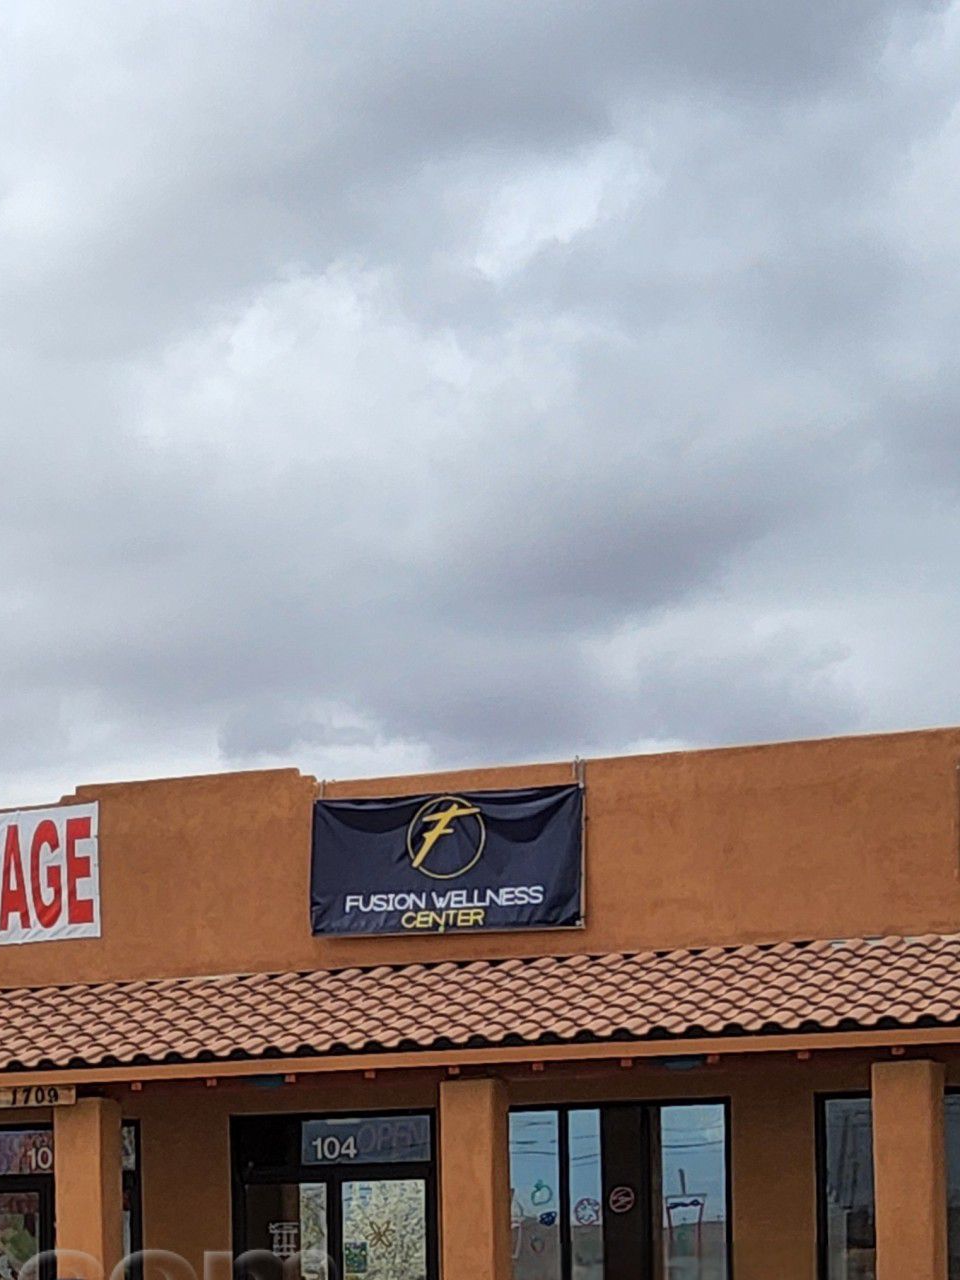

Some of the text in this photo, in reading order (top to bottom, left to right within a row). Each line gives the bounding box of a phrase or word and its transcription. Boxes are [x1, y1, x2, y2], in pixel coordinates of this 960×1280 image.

[345, 885, 544, 913] FUSION WELLNESS
[401, 908, 484, 928] CENTER
[11, 1087, 59, 1105] 1709
[27, 1146, 53, 1170] 10
[311, 1136, 358, 1160] 104
